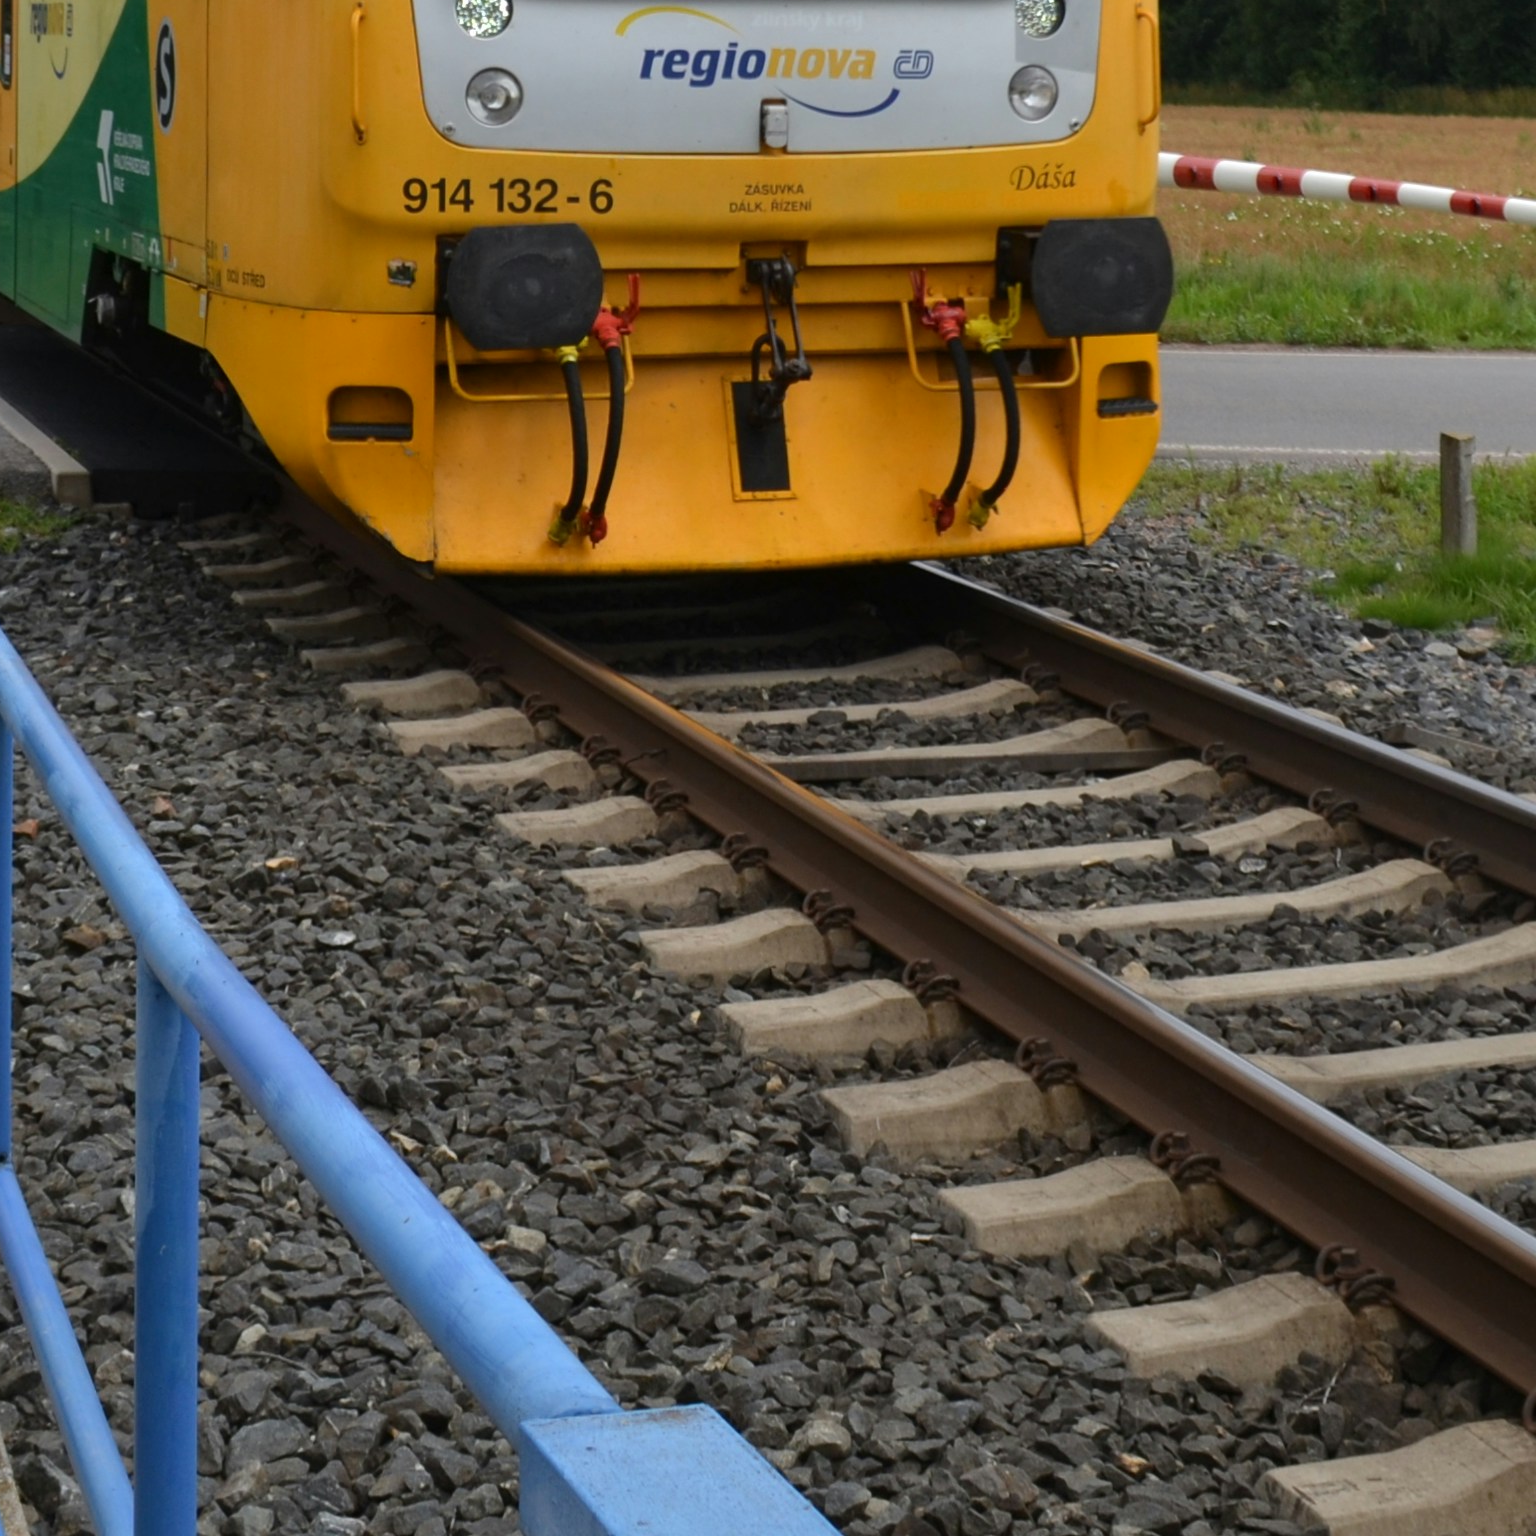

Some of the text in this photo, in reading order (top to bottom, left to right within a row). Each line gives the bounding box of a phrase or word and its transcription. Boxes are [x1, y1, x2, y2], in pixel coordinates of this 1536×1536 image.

[639, 42, 876, 87] regionova
[744, 181, 805, 196] ZÁSUVKA
[1009, 163, 1077, 192] Dáša
[402, 177, 475, 214] 914
[770, 197, 812, 213] ŘÍZENÍ
